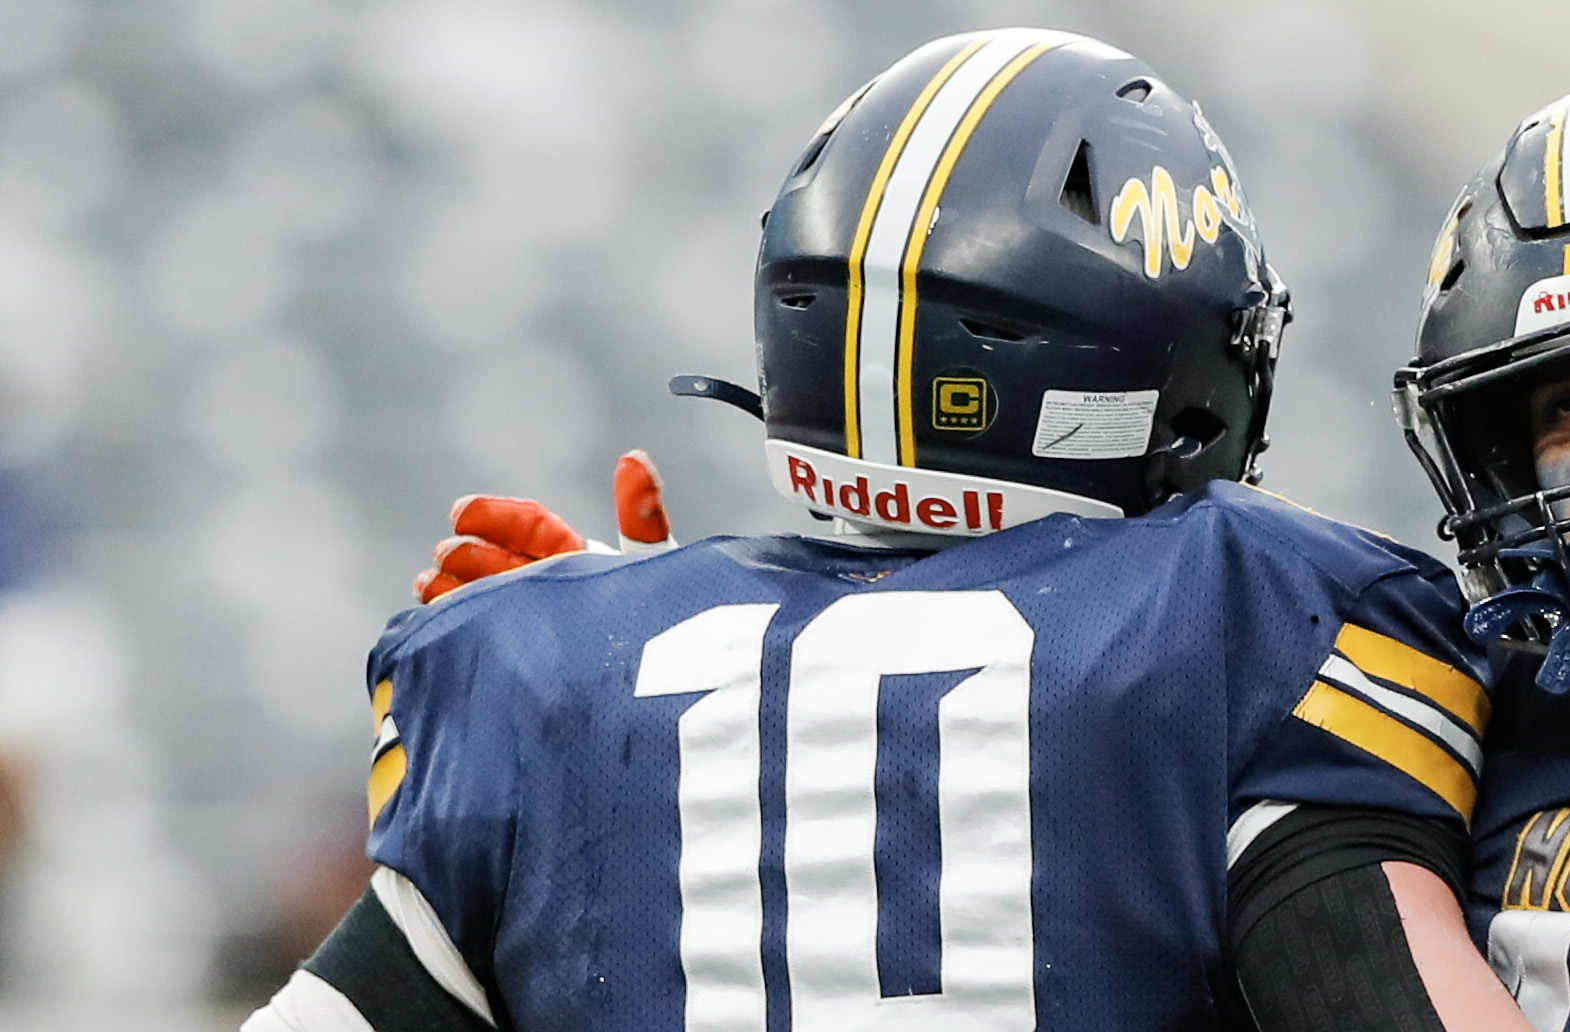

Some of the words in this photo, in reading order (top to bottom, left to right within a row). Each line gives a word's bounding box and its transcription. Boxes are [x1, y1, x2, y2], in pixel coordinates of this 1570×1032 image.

[940, 383, 979, 414] C
[1083, 394, 1126, 404] WARNING
[787, 453, 1003, 531] Riddell
